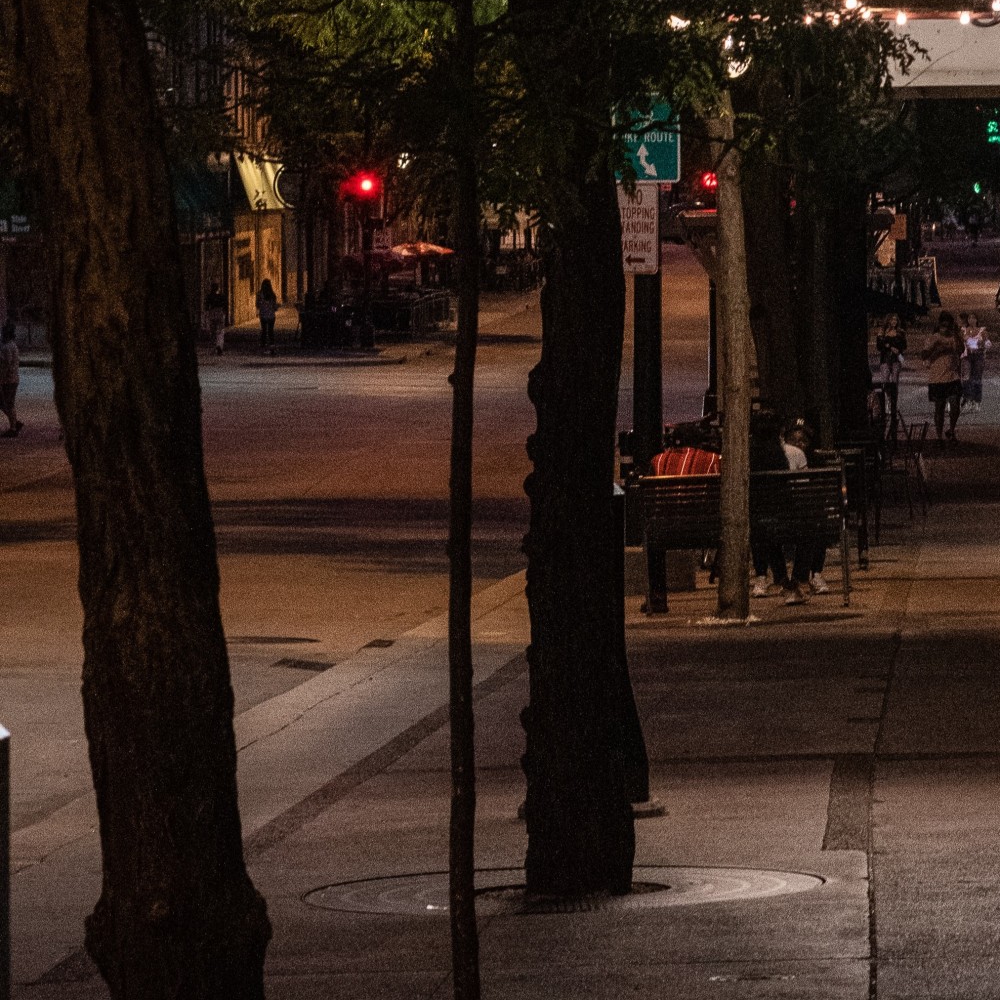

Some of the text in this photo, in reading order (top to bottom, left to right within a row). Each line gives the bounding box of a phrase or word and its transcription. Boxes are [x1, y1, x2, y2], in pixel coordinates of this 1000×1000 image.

[643, 132, 674, 143] ROUTE
[621, 207, 655, 220] TOPPING
[622, 221, 655, 234] TANDING
[623, 240, 652, 253] ARKING
